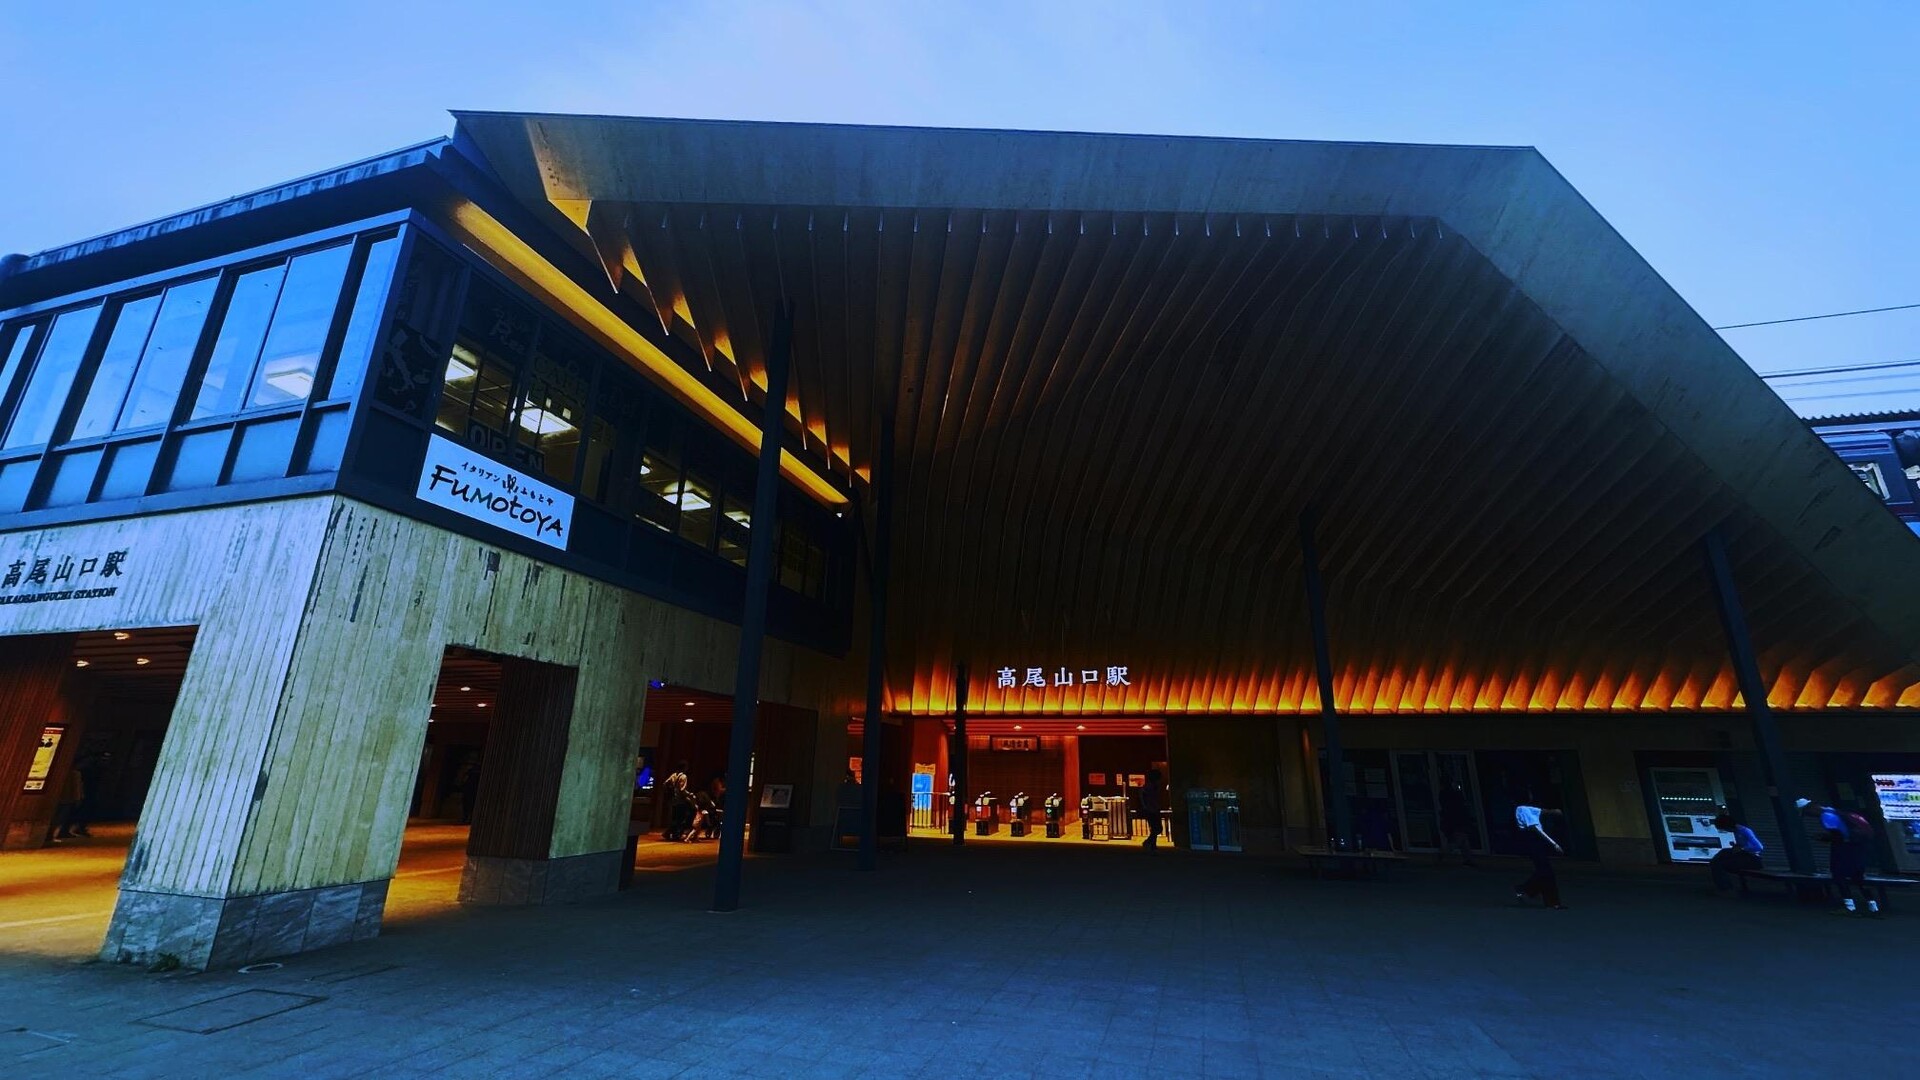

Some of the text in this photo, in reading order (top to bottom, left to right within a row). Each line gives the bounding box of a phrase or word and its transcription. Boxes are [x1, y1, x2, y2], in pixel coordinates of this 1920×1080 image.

[461, 461, 501, 482] イタリアン
[2, 550, 128, 588] 高尾山口駅
[0, 587, 118, 604] AKAOSANGUCHI STATION
[996, 666, 1132, 689] 高尾山口駅
